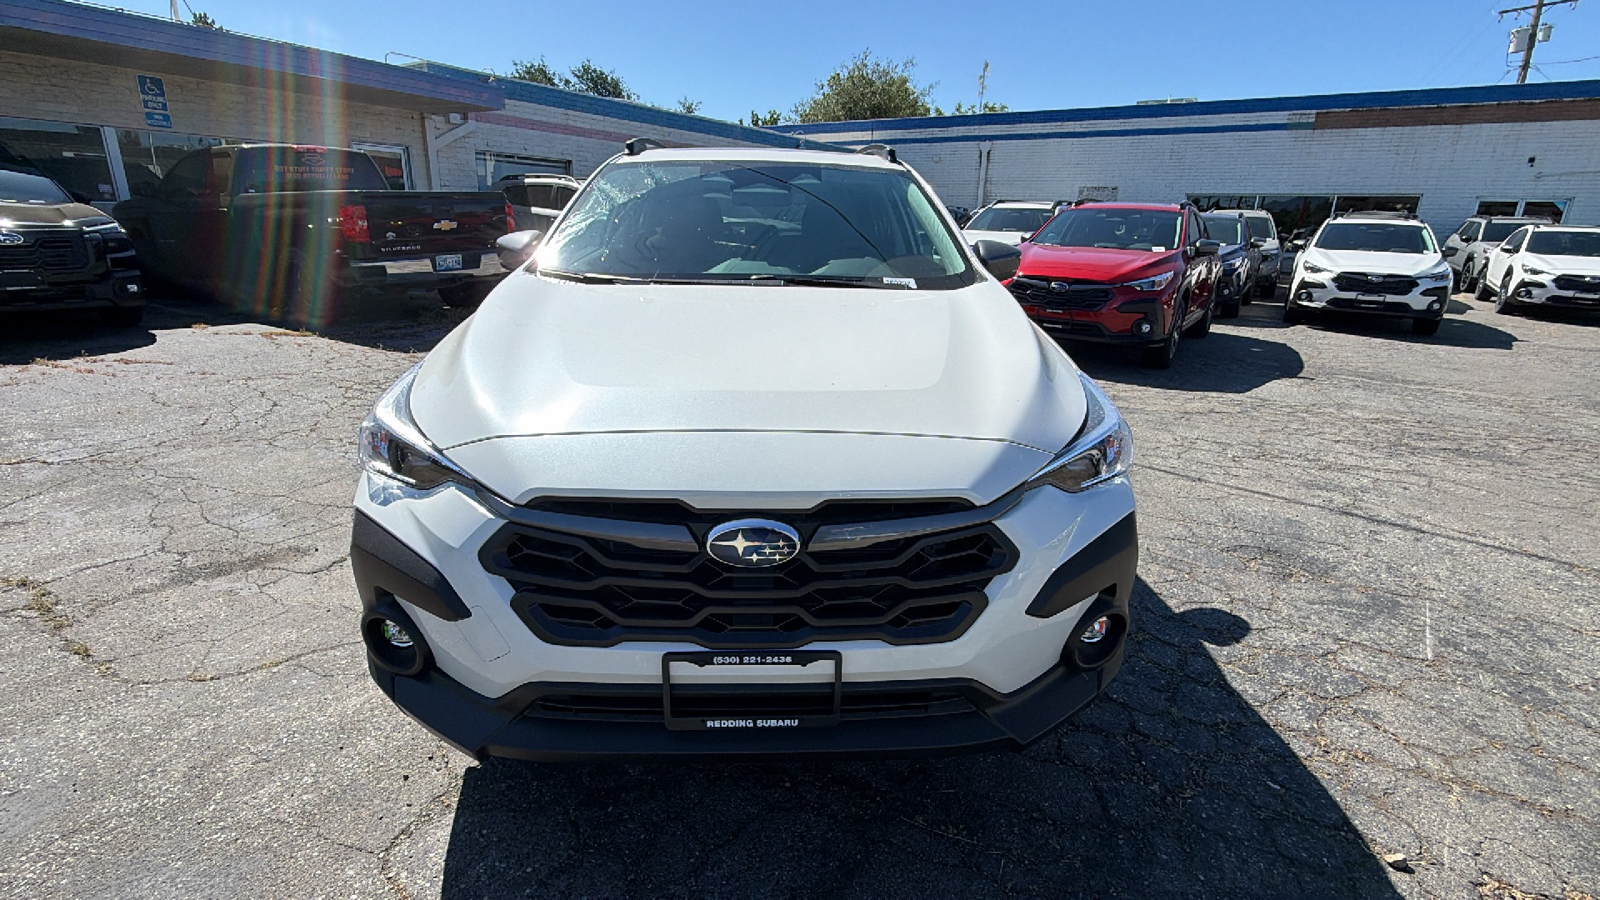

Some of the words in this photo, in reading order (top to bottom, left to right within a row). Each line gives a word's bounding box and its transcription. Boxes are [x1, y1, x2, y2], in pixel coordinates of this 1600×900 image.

[713, 656, 740, 664] (530)
[743, 656, 792, 664] 221-2436
[706, 720, 754, 728] REDDING
[756, 719, 799, 727] SUBARU
